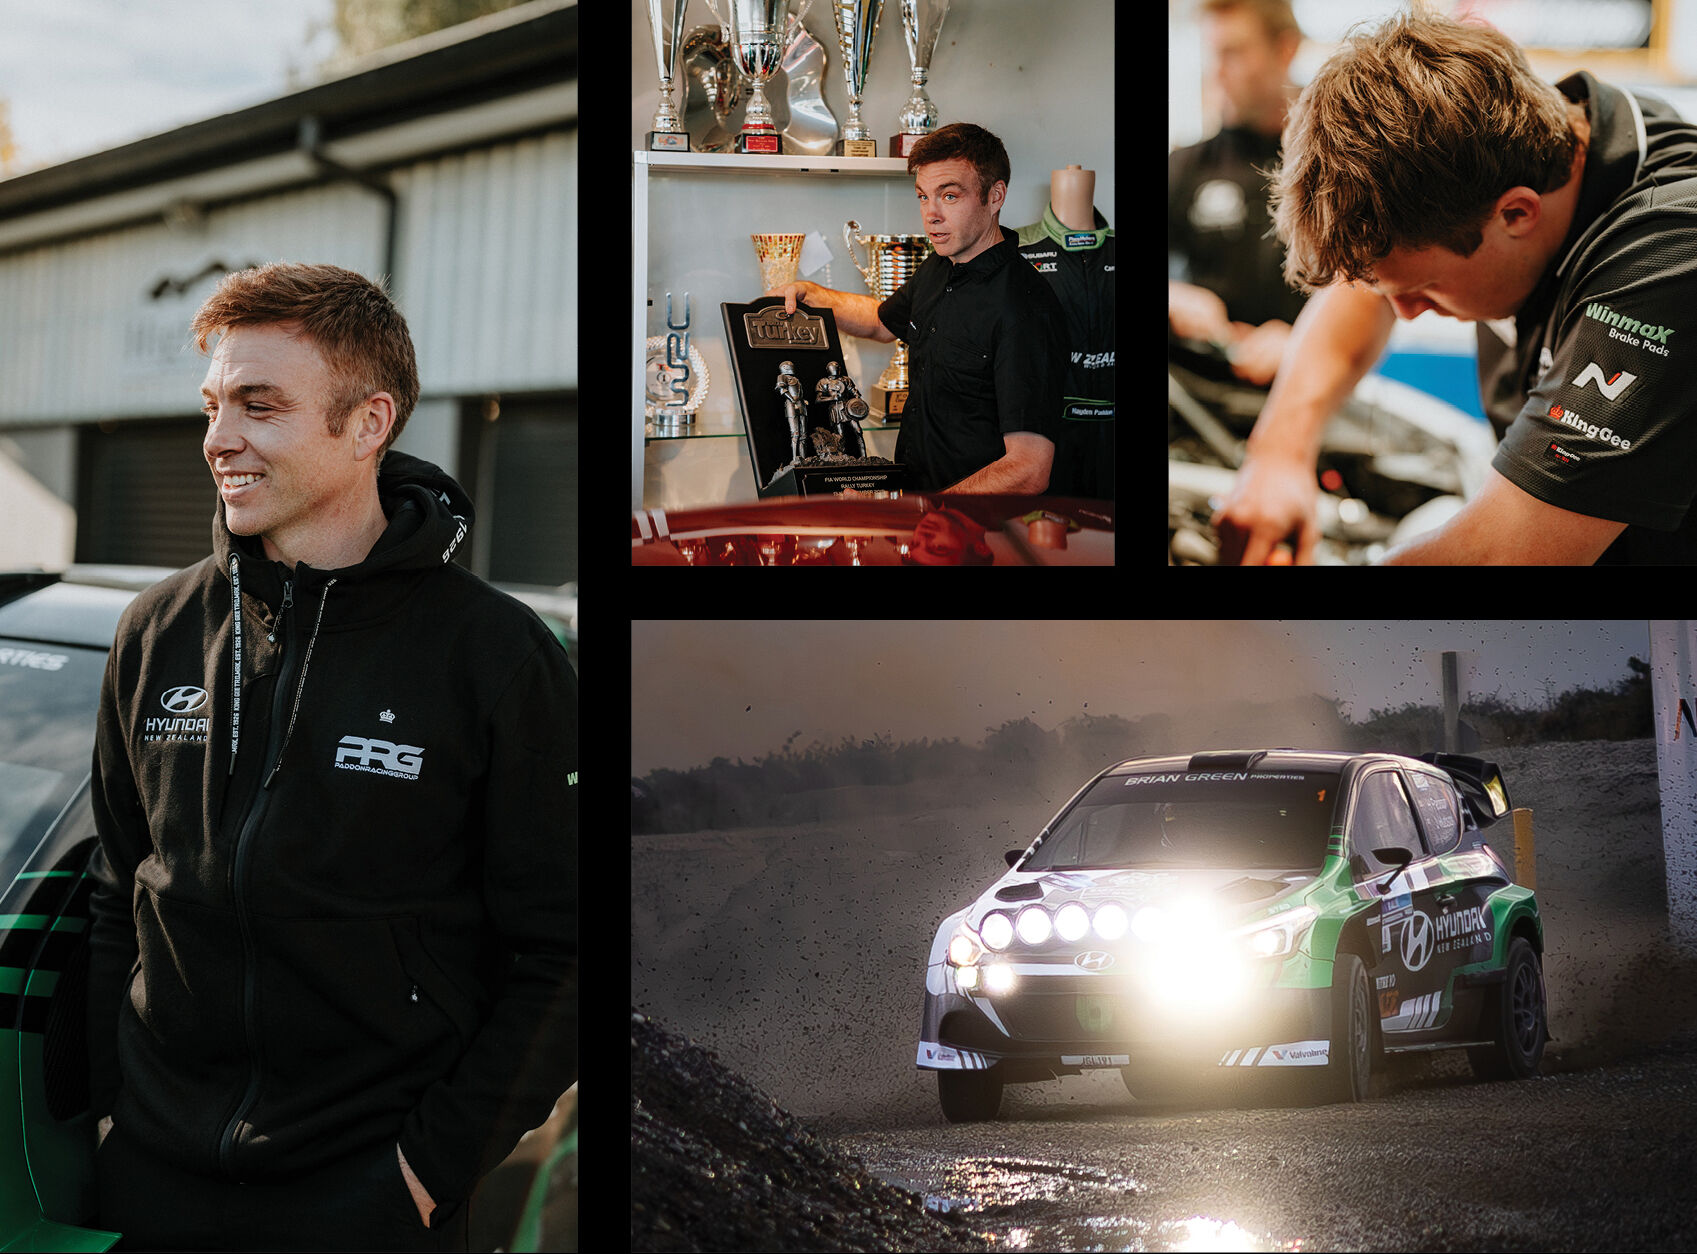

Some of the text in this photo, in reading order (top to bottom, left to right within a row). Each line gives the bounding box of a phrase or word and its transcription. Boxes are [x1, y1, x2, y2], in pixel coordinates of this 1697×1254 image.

[753, 321, 819, 343] Turkey
[1608, 328, 1670, 357] Brake Pads
[1560, 409, 1631, 449] KingGee
[146, 717, 209, 731] HYUNDAI
[336, 735, 425, 775] PRG
[334, 762, 419, 780] PADDONRACINGGROUP
[1124, 774, 1181, 786] BRIAN
[1184, 772, 1248, 782] GREEN
[1435, 906, 1487, 942] HYUNDAI
[1289, 1049, 1328, 1060] Valvoline
